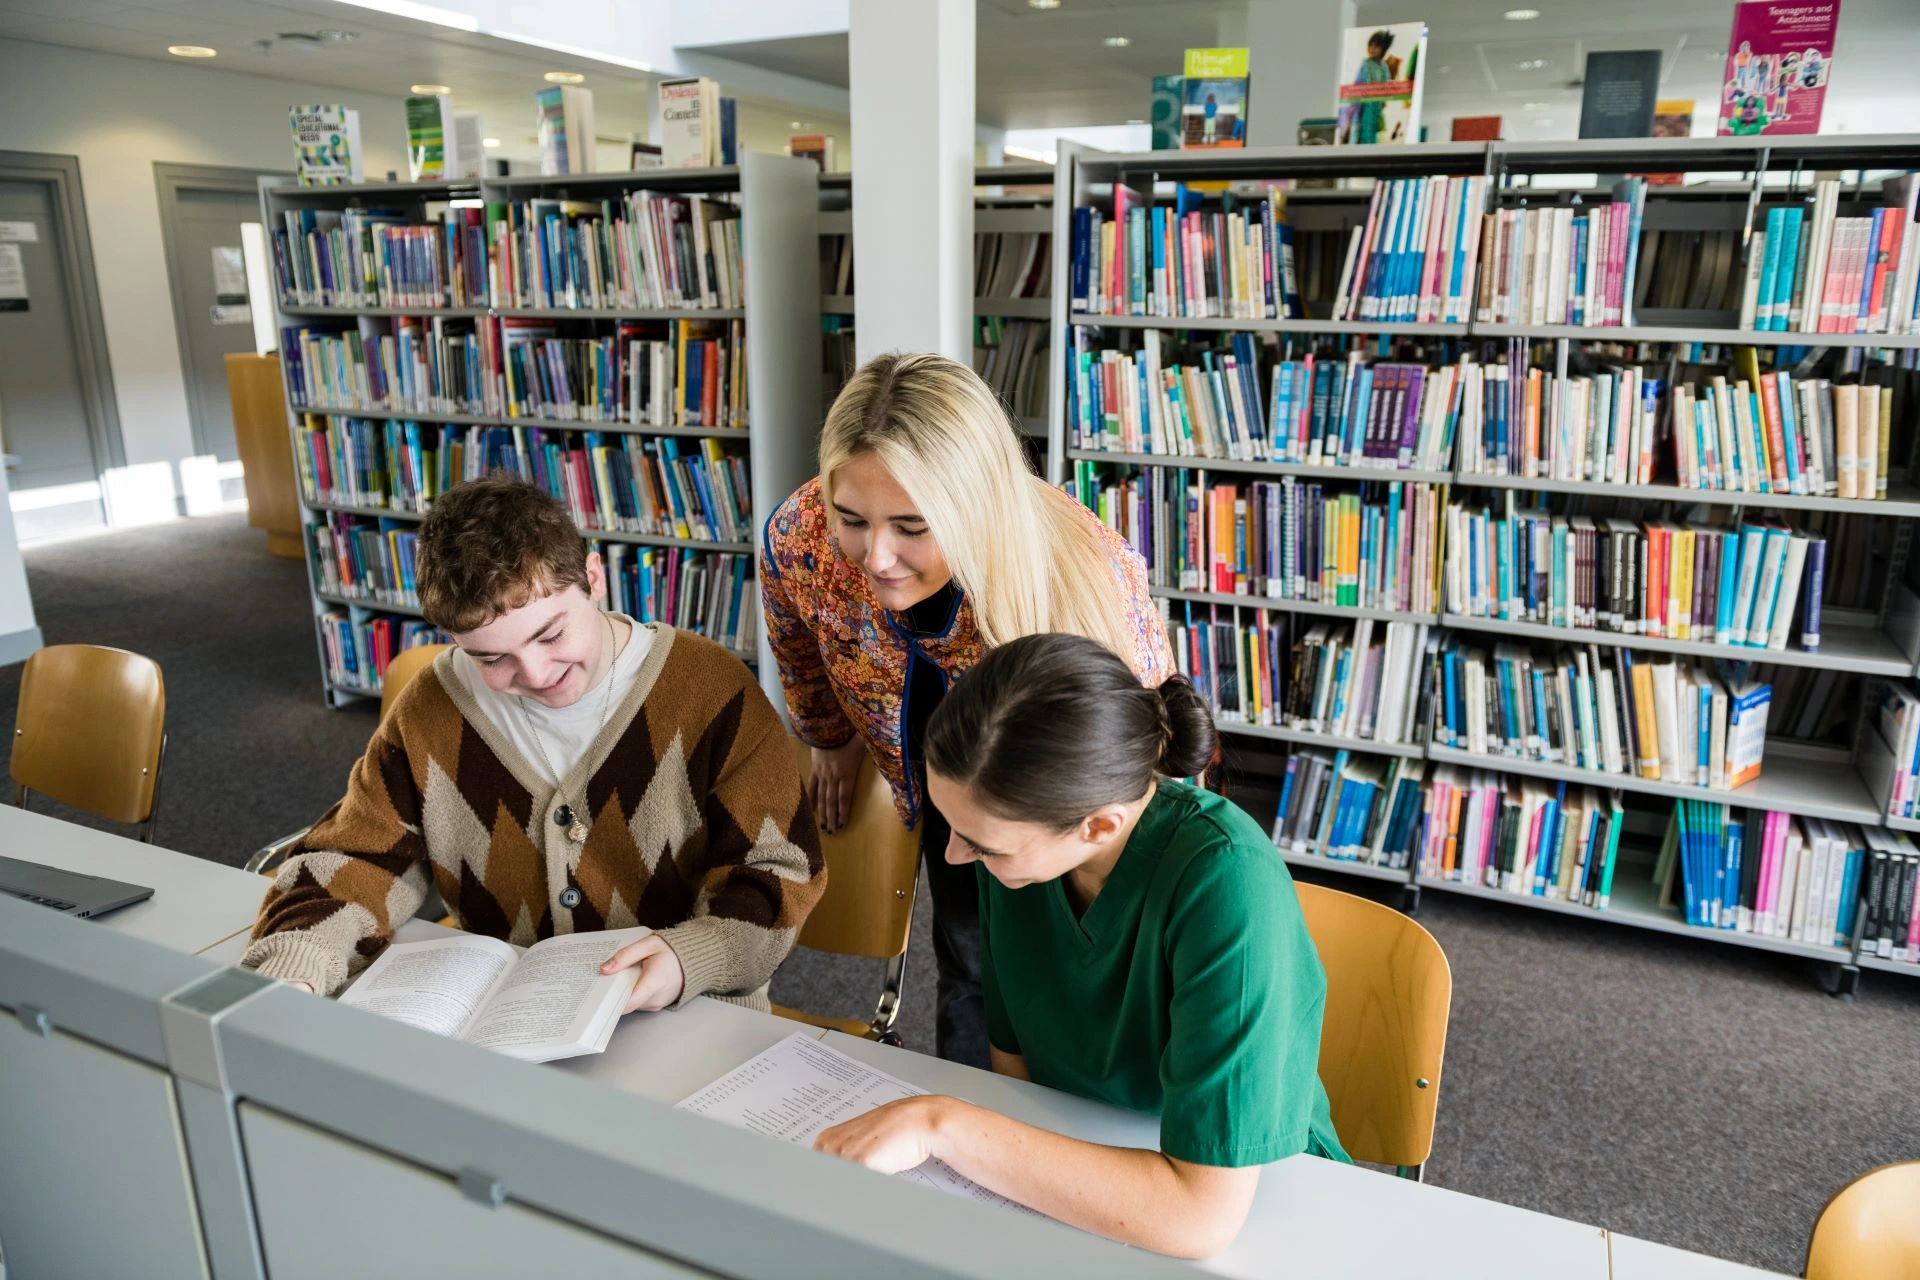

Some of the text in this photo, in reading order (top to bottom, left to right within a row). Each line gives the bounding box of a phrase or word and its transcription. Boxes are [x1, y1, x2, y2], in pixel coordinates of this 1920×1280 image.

[1769, 4, 1832, 16] Teenagers and
[1777, 15, 1831, 24] Attachment
